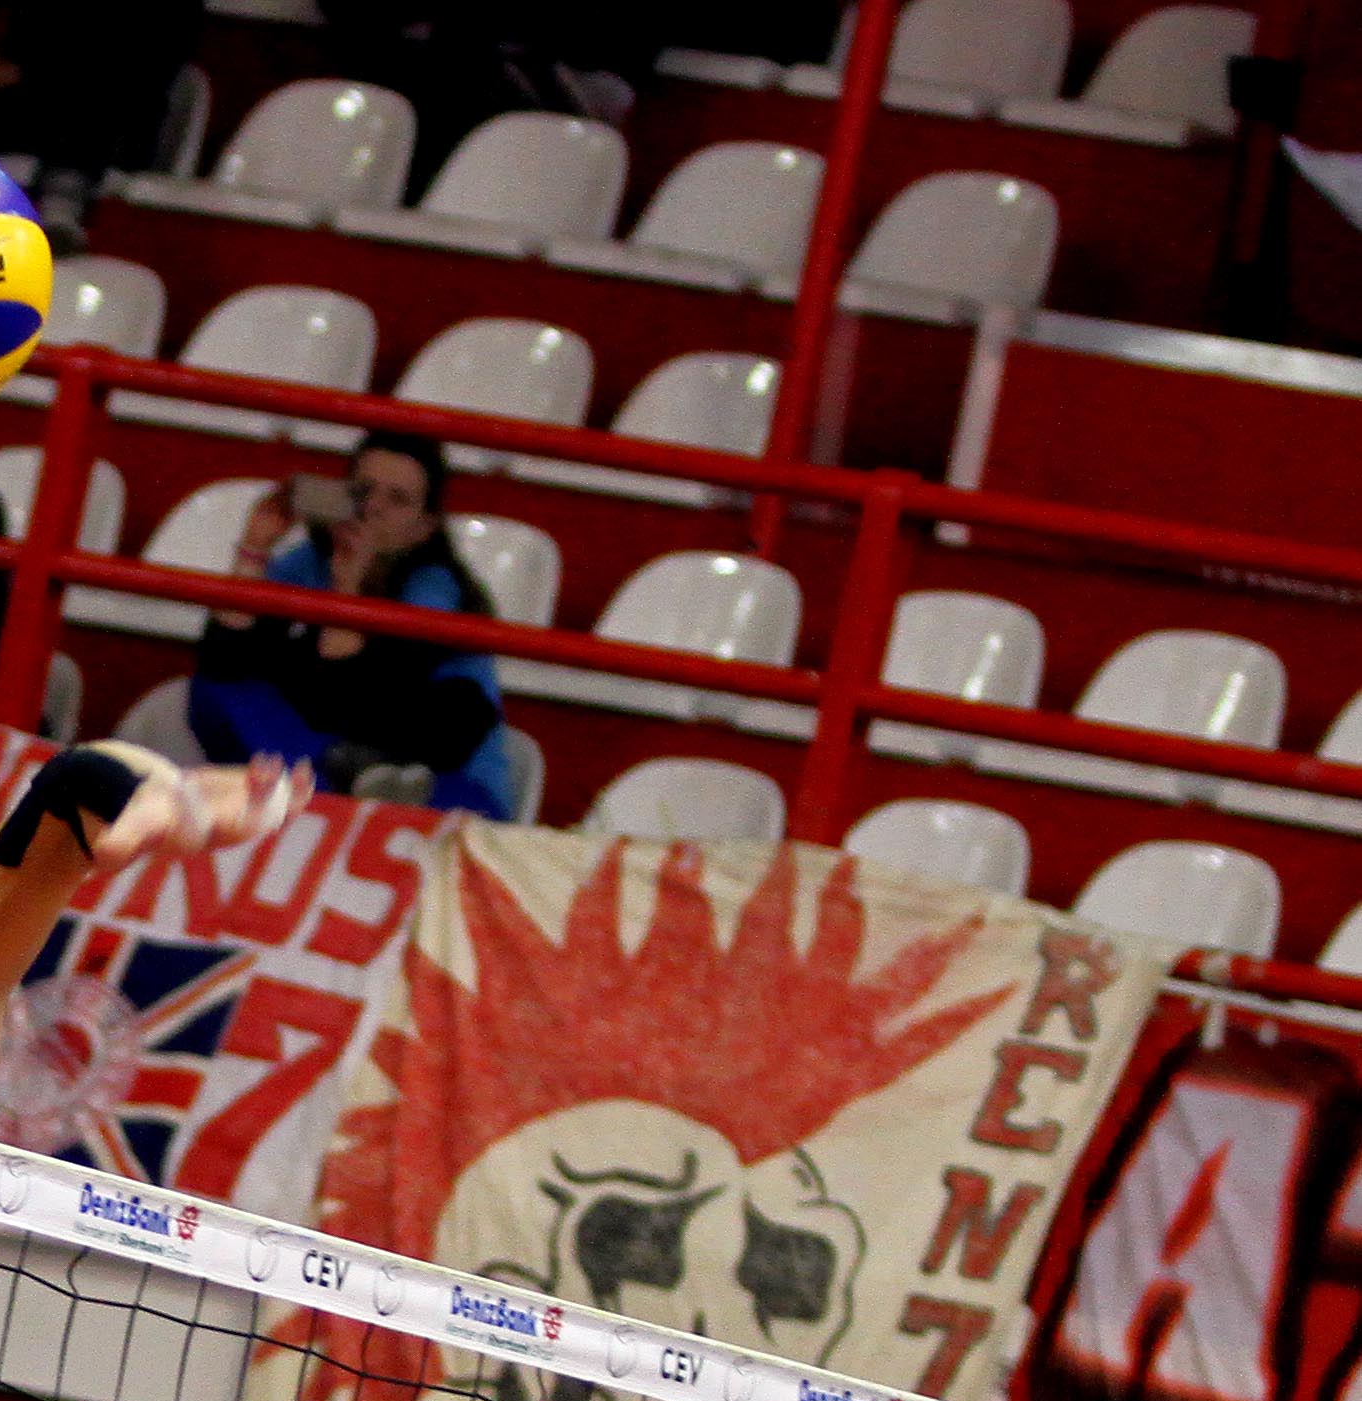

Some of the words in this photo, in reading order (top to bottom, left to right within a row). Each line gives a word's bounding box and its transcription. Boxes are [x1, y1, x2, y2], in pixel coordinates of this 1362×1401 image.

[79, 1182, 171, 1237] DenizBank
[302, 1248, 351, 1293] CEV
[450, 1285, 538, 1338] DenizBank
[661, 1347, 704, 1386] CEV
